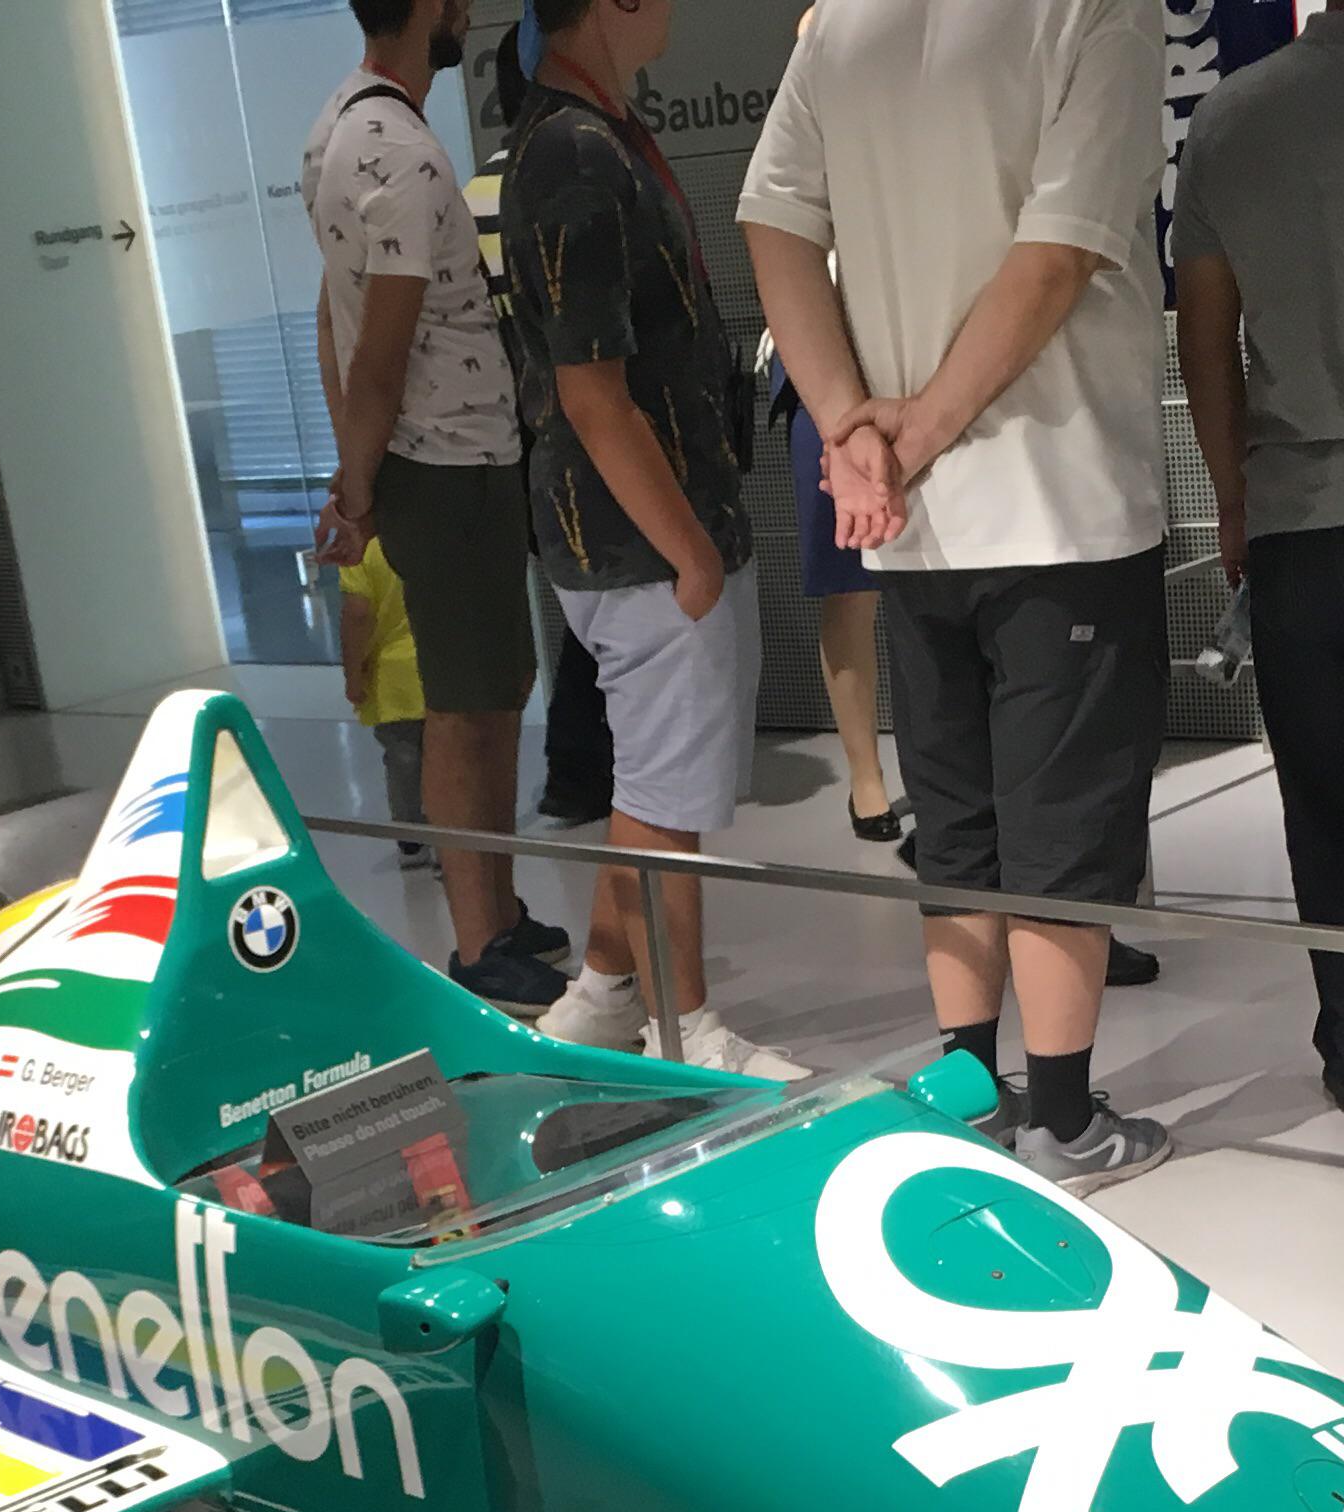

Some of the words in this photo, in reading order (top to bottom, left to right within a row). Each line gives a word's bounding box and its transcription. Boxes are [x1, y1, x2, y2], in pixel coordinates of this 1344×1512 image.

[40, 1062, 96, 1096] Berger
[219, 1083, 297, 1129] Benetton
[303, 1050, 371, 1093] Formula
[292, 1116, 330, 1140] Bitte
[333, 1098, 368, 1123] nicht
[304, 1130, 355, 1161] Please
[355, 1122, 376, 1140] do
[377, 1114, 401, 1133] not
